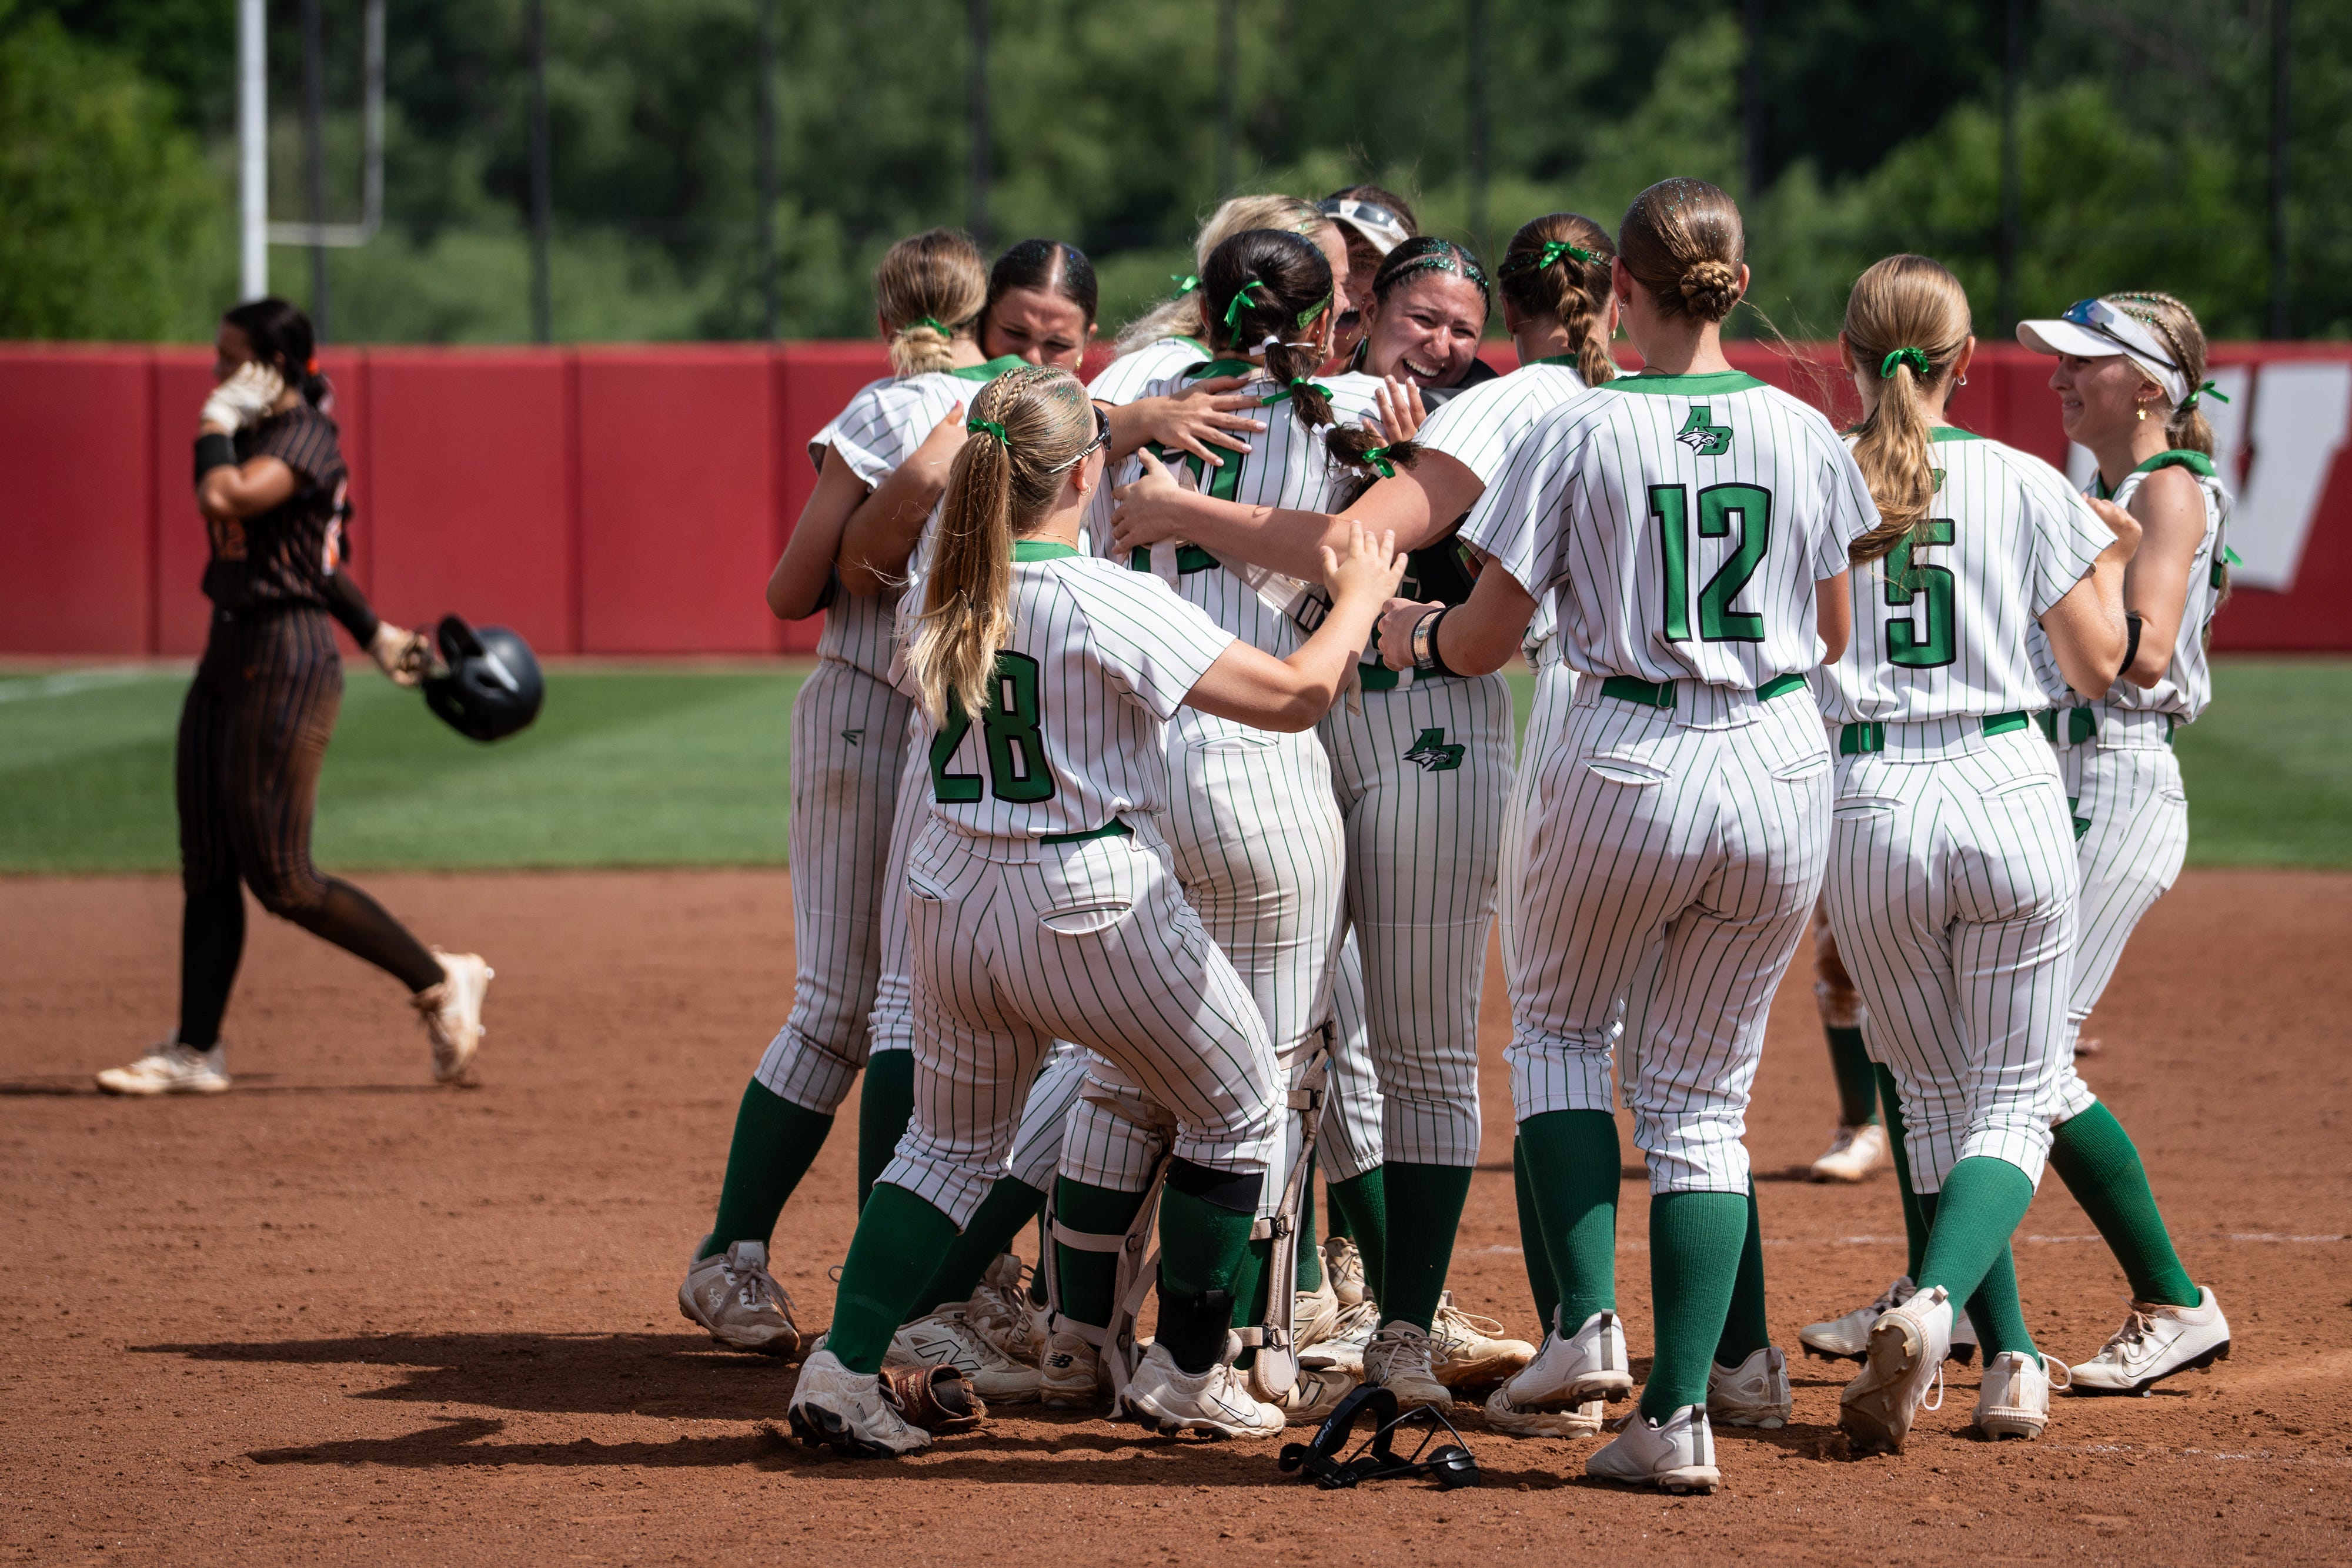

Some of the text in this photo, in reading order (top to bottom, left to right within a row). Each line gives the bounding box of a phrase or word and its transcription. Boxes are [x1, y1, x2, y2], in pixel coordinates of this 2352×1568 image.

[1676, 406, 1733, 456] AB
[1648, 482, 1772, 643] 12
[1883, 518, 1956, 669] 5
[929, 650, 1056, 804] 28
[1404, 727, 1466, 772] AB
[1315, 1418, 1332, 1447] RIP-IT
